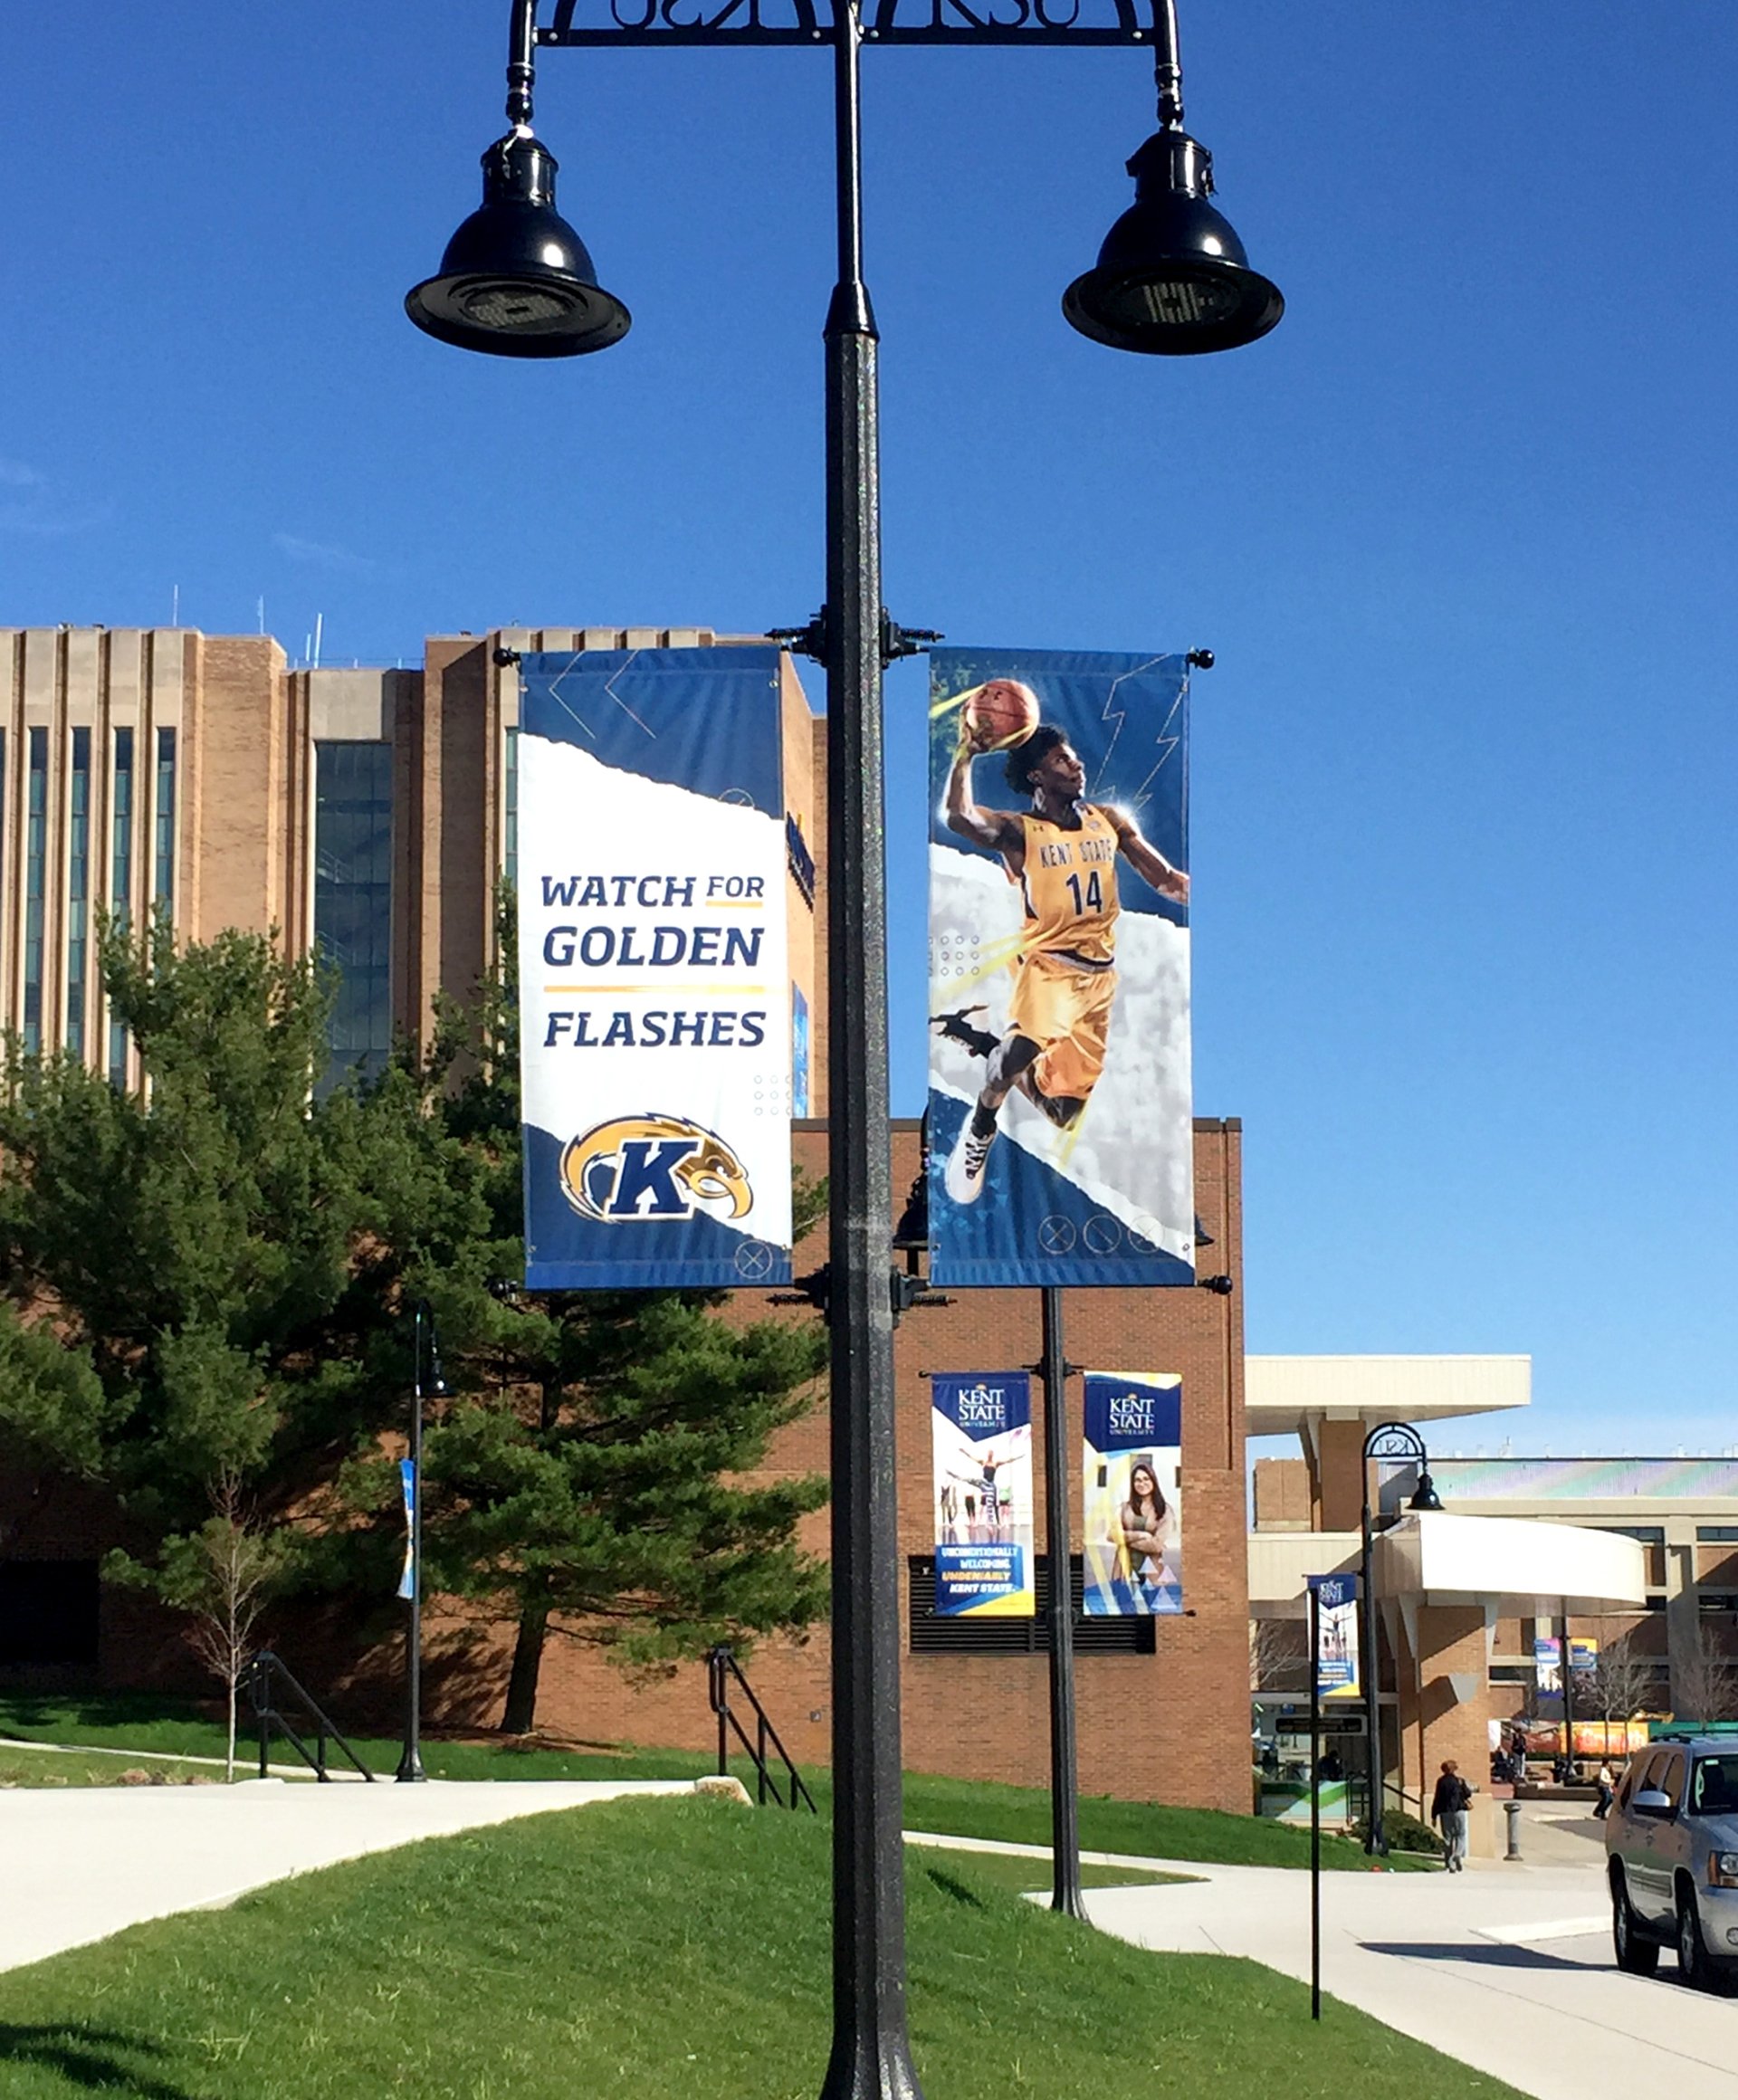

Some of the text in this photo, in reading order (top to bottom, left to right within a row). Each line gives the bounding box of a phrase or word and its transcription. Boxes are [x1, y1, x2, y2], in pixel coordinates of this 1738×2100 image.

[1040, 839, 1112, 868] KENT STATE
[541, 875, 697, 907] WATCH
[706, 876, 765, 898] FOR
[1065, 871, 1102, 916] 14
[543, 925, 765, 967] GOLDEN
[543, 1010, 767, 1047] FLASHES
[607, 1141, 700, 1217] K
[959, 1389, 1005, 1405] KENT
[1110, 1398, 1155, 1413] KENT
[959, 1405, 1006, 1420] STATE
[1110, 1413, 1155, 1428] STATE
[950, 1583, 979, 1593] KENT
